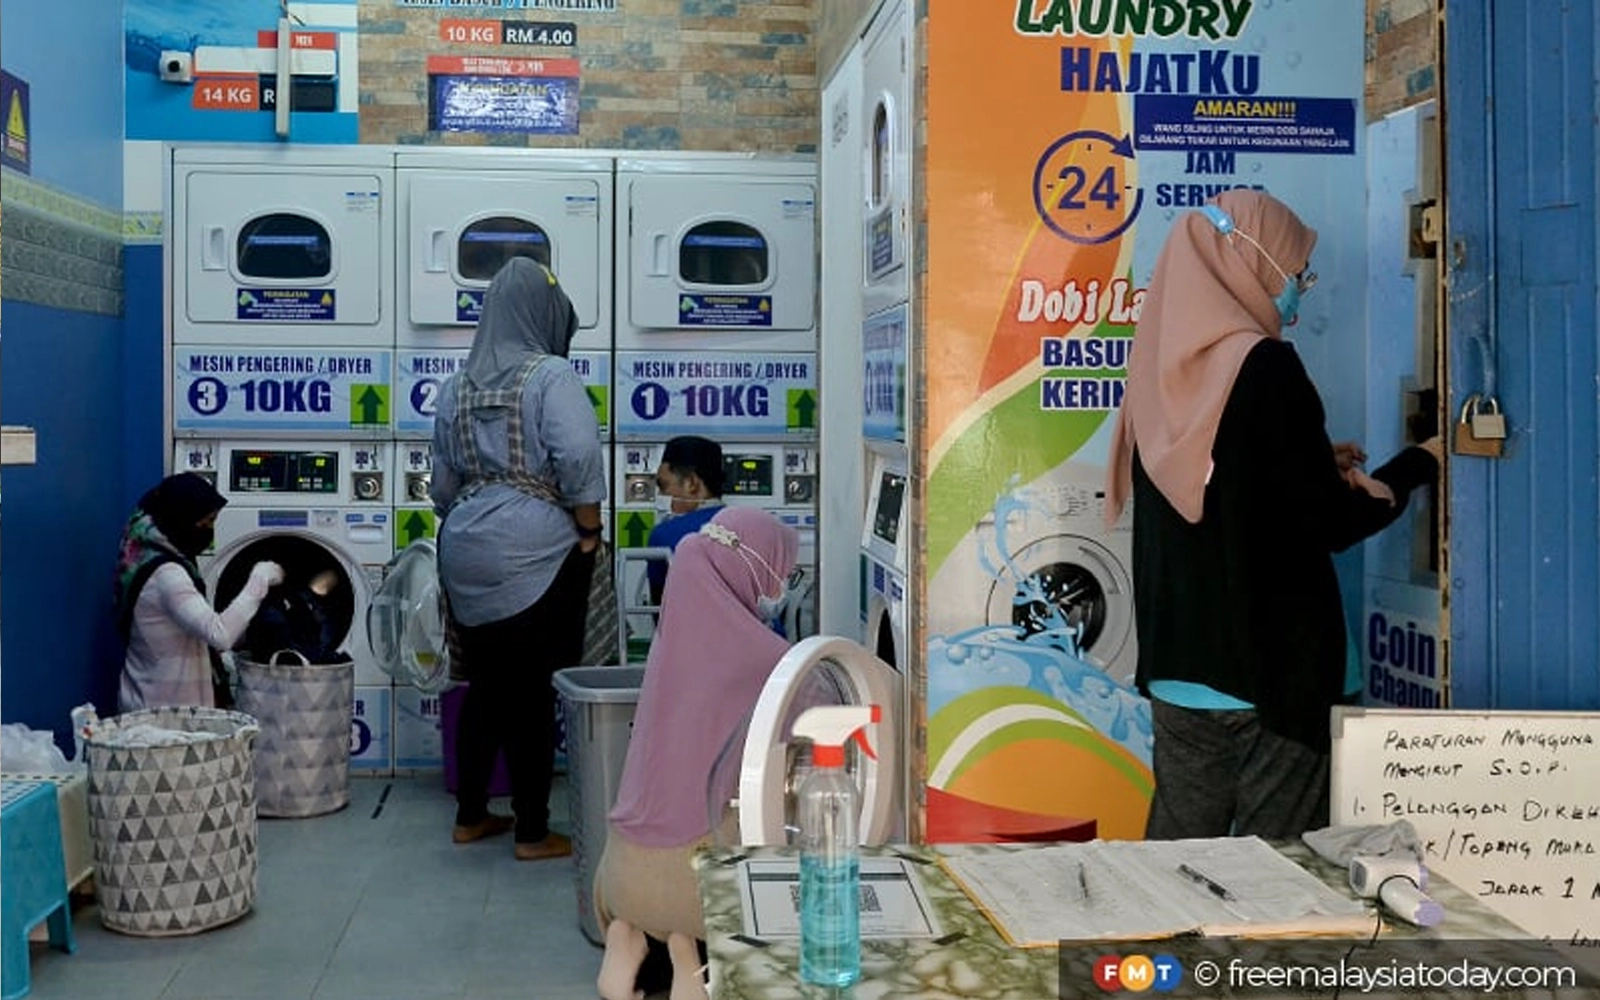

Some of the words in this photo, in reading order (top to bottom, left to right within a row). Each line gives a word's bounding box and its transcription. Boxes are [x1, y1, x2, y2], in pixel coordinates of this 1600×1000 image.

[1015, 0, 1253, 40] LAUNDRY
[447, 27, 466, 42] 10
[471, 28, 495, 43] KG
[506, 29, 535, 44] RM
[538, 30, 573, 45] 4.00
[202, 88, 223, 102] 14
[227, 88, 252, 103] KG
[1193, 100, 1296, 118] AMARAN!!!
[1138, 134, 1186, 145] DILARANG
[1187, 135, 1218, 146] TUKAR
[1218, 135, 1250, 146] UNTUK
[1153, 123, 1182, 133] WANG
[1214, 124, 1245, 135] UNTUK
[1246, 126, 1275, 135] MESIN
[1184, 151, 1236, 174] JAM
[1058, 166, 1120, 210] 24
[1017, 279, 1099, 323] Dobi
[1043, 338, 1133, 368] BASU
[189, 356, 234, 374] MESIN
[236, 357, 314, 374] PENGERING
[328, 358, 372, 375] DRYER
[412, 357, 456, 375] MESIN
[633, 362, 675, 379] MESIN
[678, 362, 753, 379] PENGERING
[765, 362, 808, 379] DRYER
[197, 381, 219, 412] 3
[239, 380, 332, 413] 10KG
[681, 385, 770, 418] 10KG
[1369, 612, 1436, 680] Coin
[1560, 875, 1575, 899] 1
